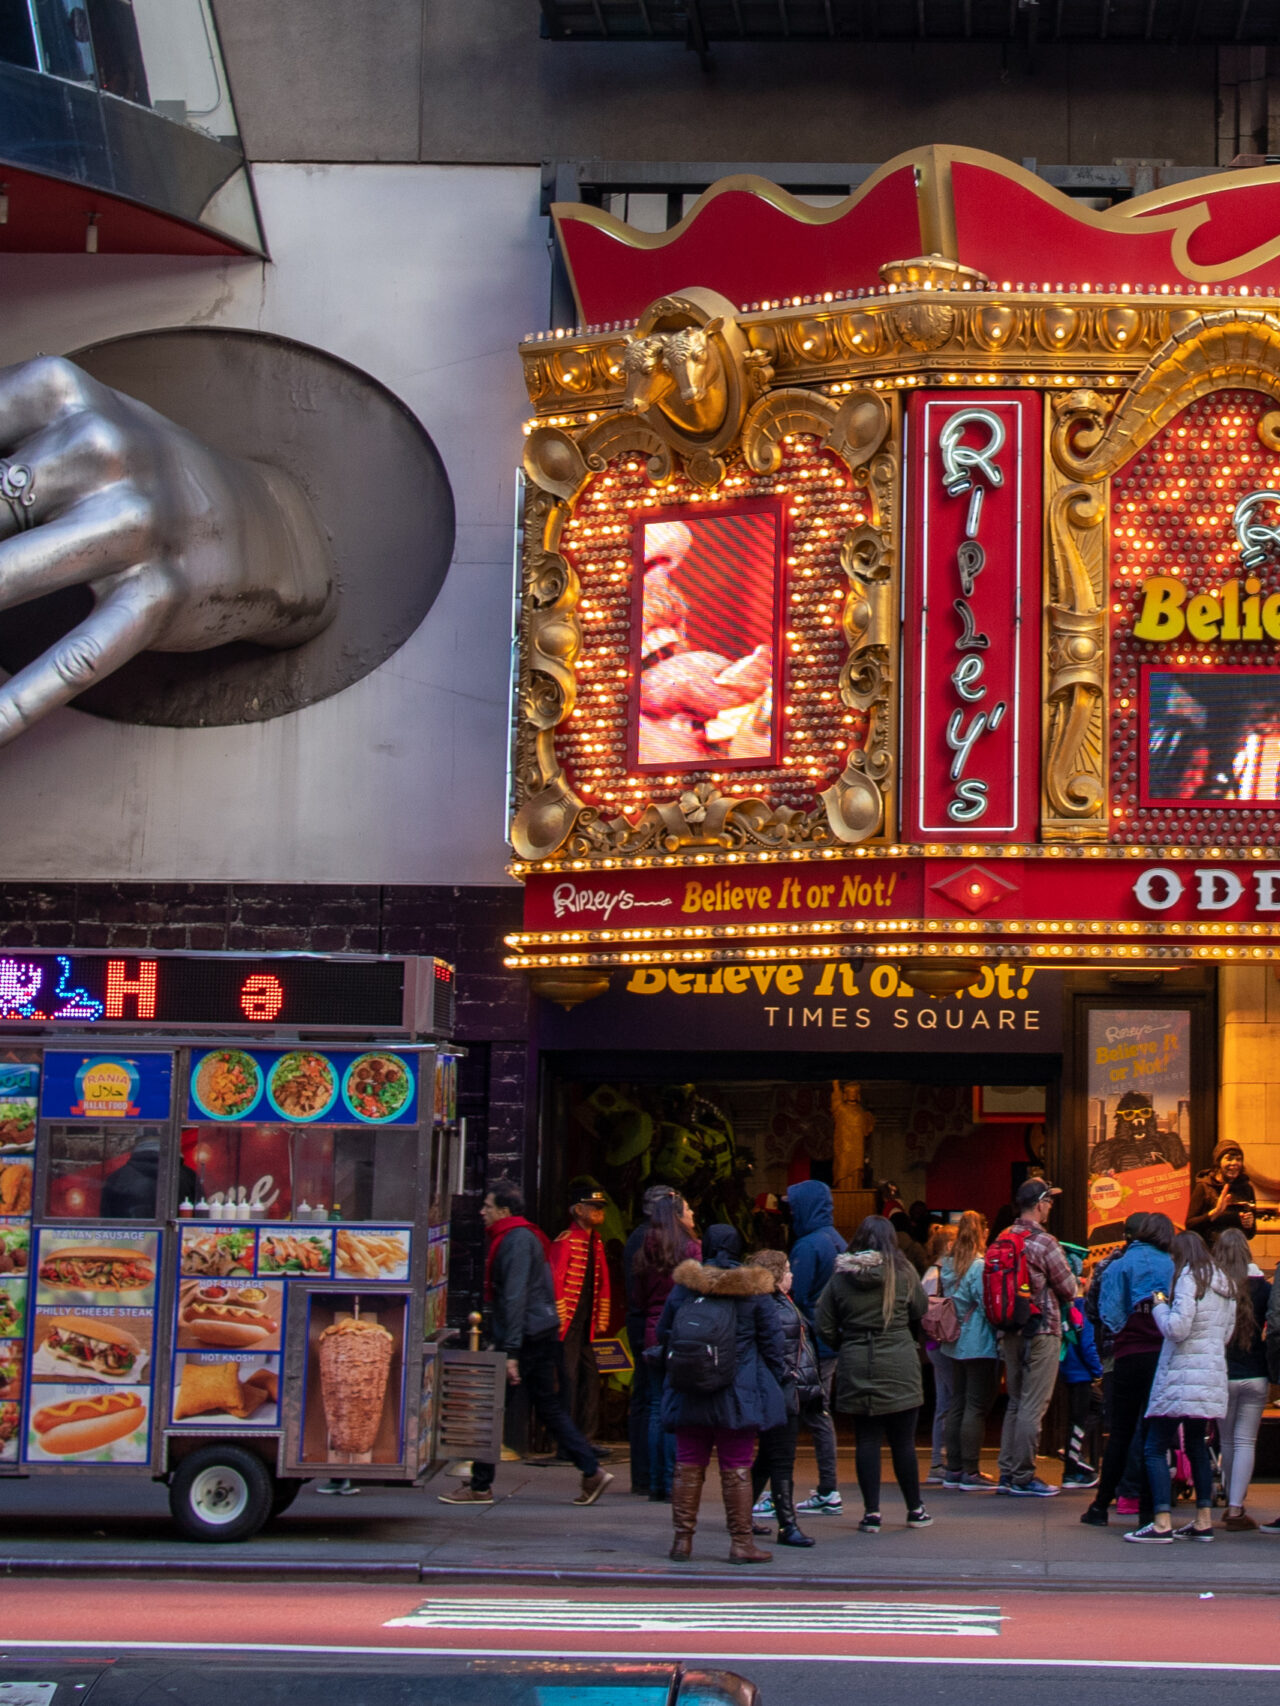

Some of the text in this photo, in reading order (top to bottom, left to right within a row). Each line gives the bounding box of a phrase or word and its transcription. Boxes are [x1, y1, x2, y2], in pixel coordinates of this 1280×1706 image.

[939, 408, 1006, 822] Ripley's
[552, 871, 897, 921] Ripley's Believe It or Not!
[106, 960, 158, 1019] H
[764, 1005, 1041, 1031] TIMES SQUARE
[1095, 1033, 1179, 1066] Believe It
[1109, 1051, 1170, 1083] or Not!
[86, 1073, 129, 1085] RANIA
[83, 1101, 128, 1111] HALAL FOOD
[52, 1230, 145, 1241] ITALIAN SAUSAGE
[199, 1280, 265, 1290] HOT SAUSAGE
[36, 1307, 153, 1318] PHILLY CHEESE STEAK
[201, 1353, 255, 1363] HOT KNOSH
